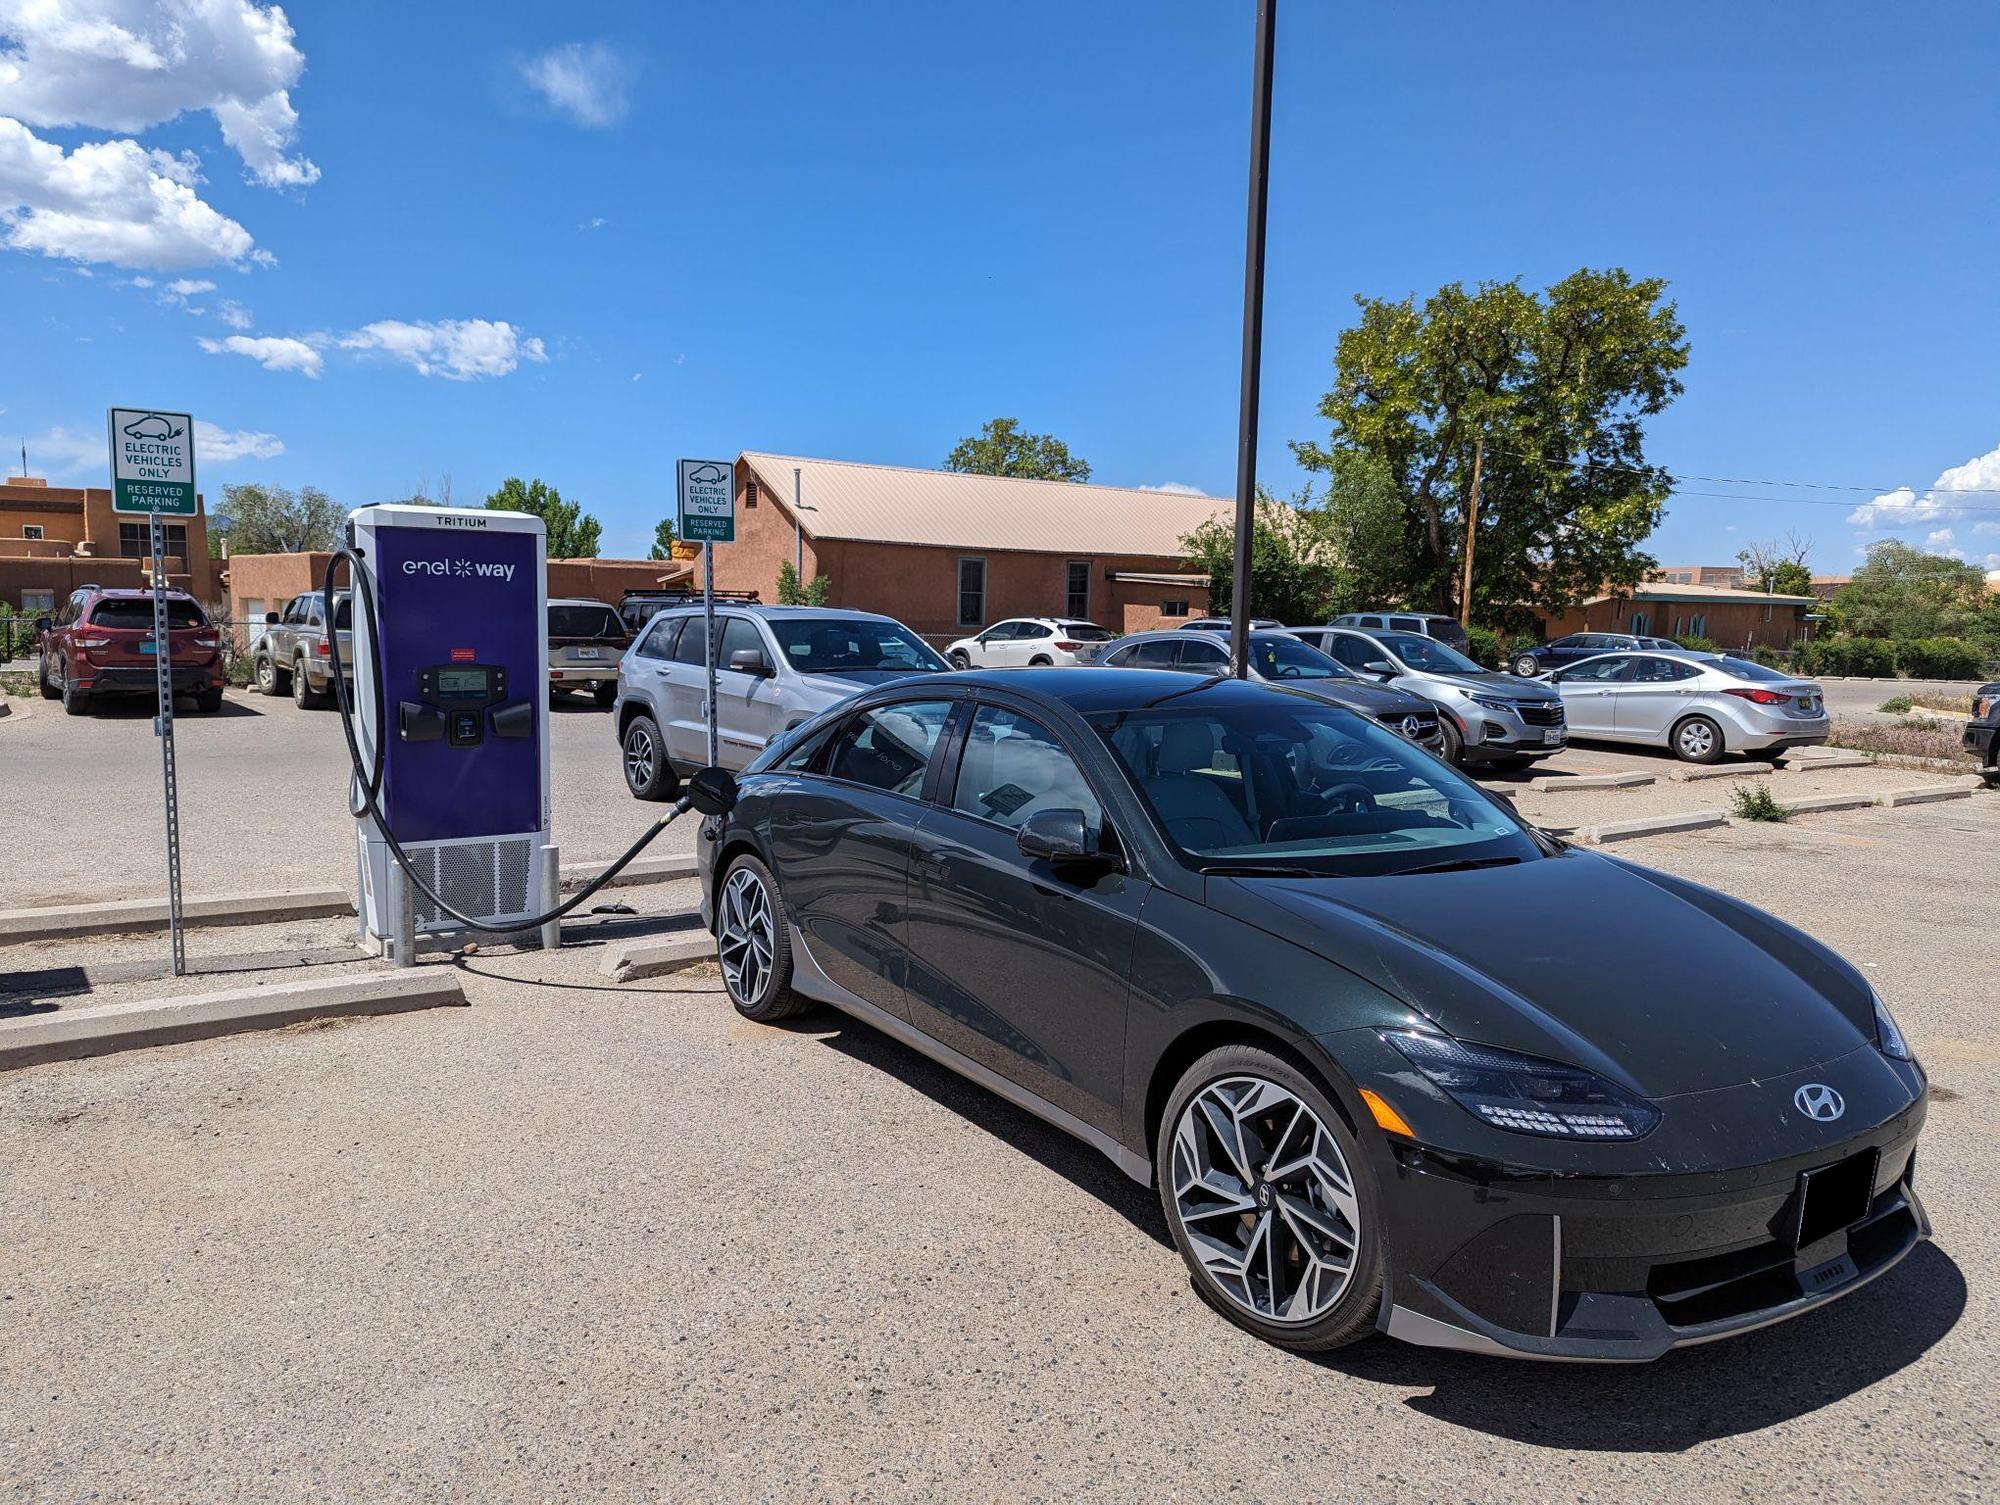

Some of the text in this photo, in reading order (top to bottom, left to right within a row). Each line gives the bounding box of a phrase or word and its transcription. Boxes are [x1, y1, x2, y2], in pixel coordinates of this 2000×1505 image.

[125, 443, 181, 455] ELECTRIC
[125, 455, 182, 467] VEHICLES
[139, 468, 170, 478] ONLY
[127, 485, 183, 496] RESERVED
[690, 486, 726, 495] ELECTRIC
[132, 496, 180, 506] PARKING
[690, 496, 727, 505] VEHICLES
[436, 516, 487, 527] TRITIUM
[693, 528, 725, 536] PARKING
[402, 558, 515, 581] enel way
